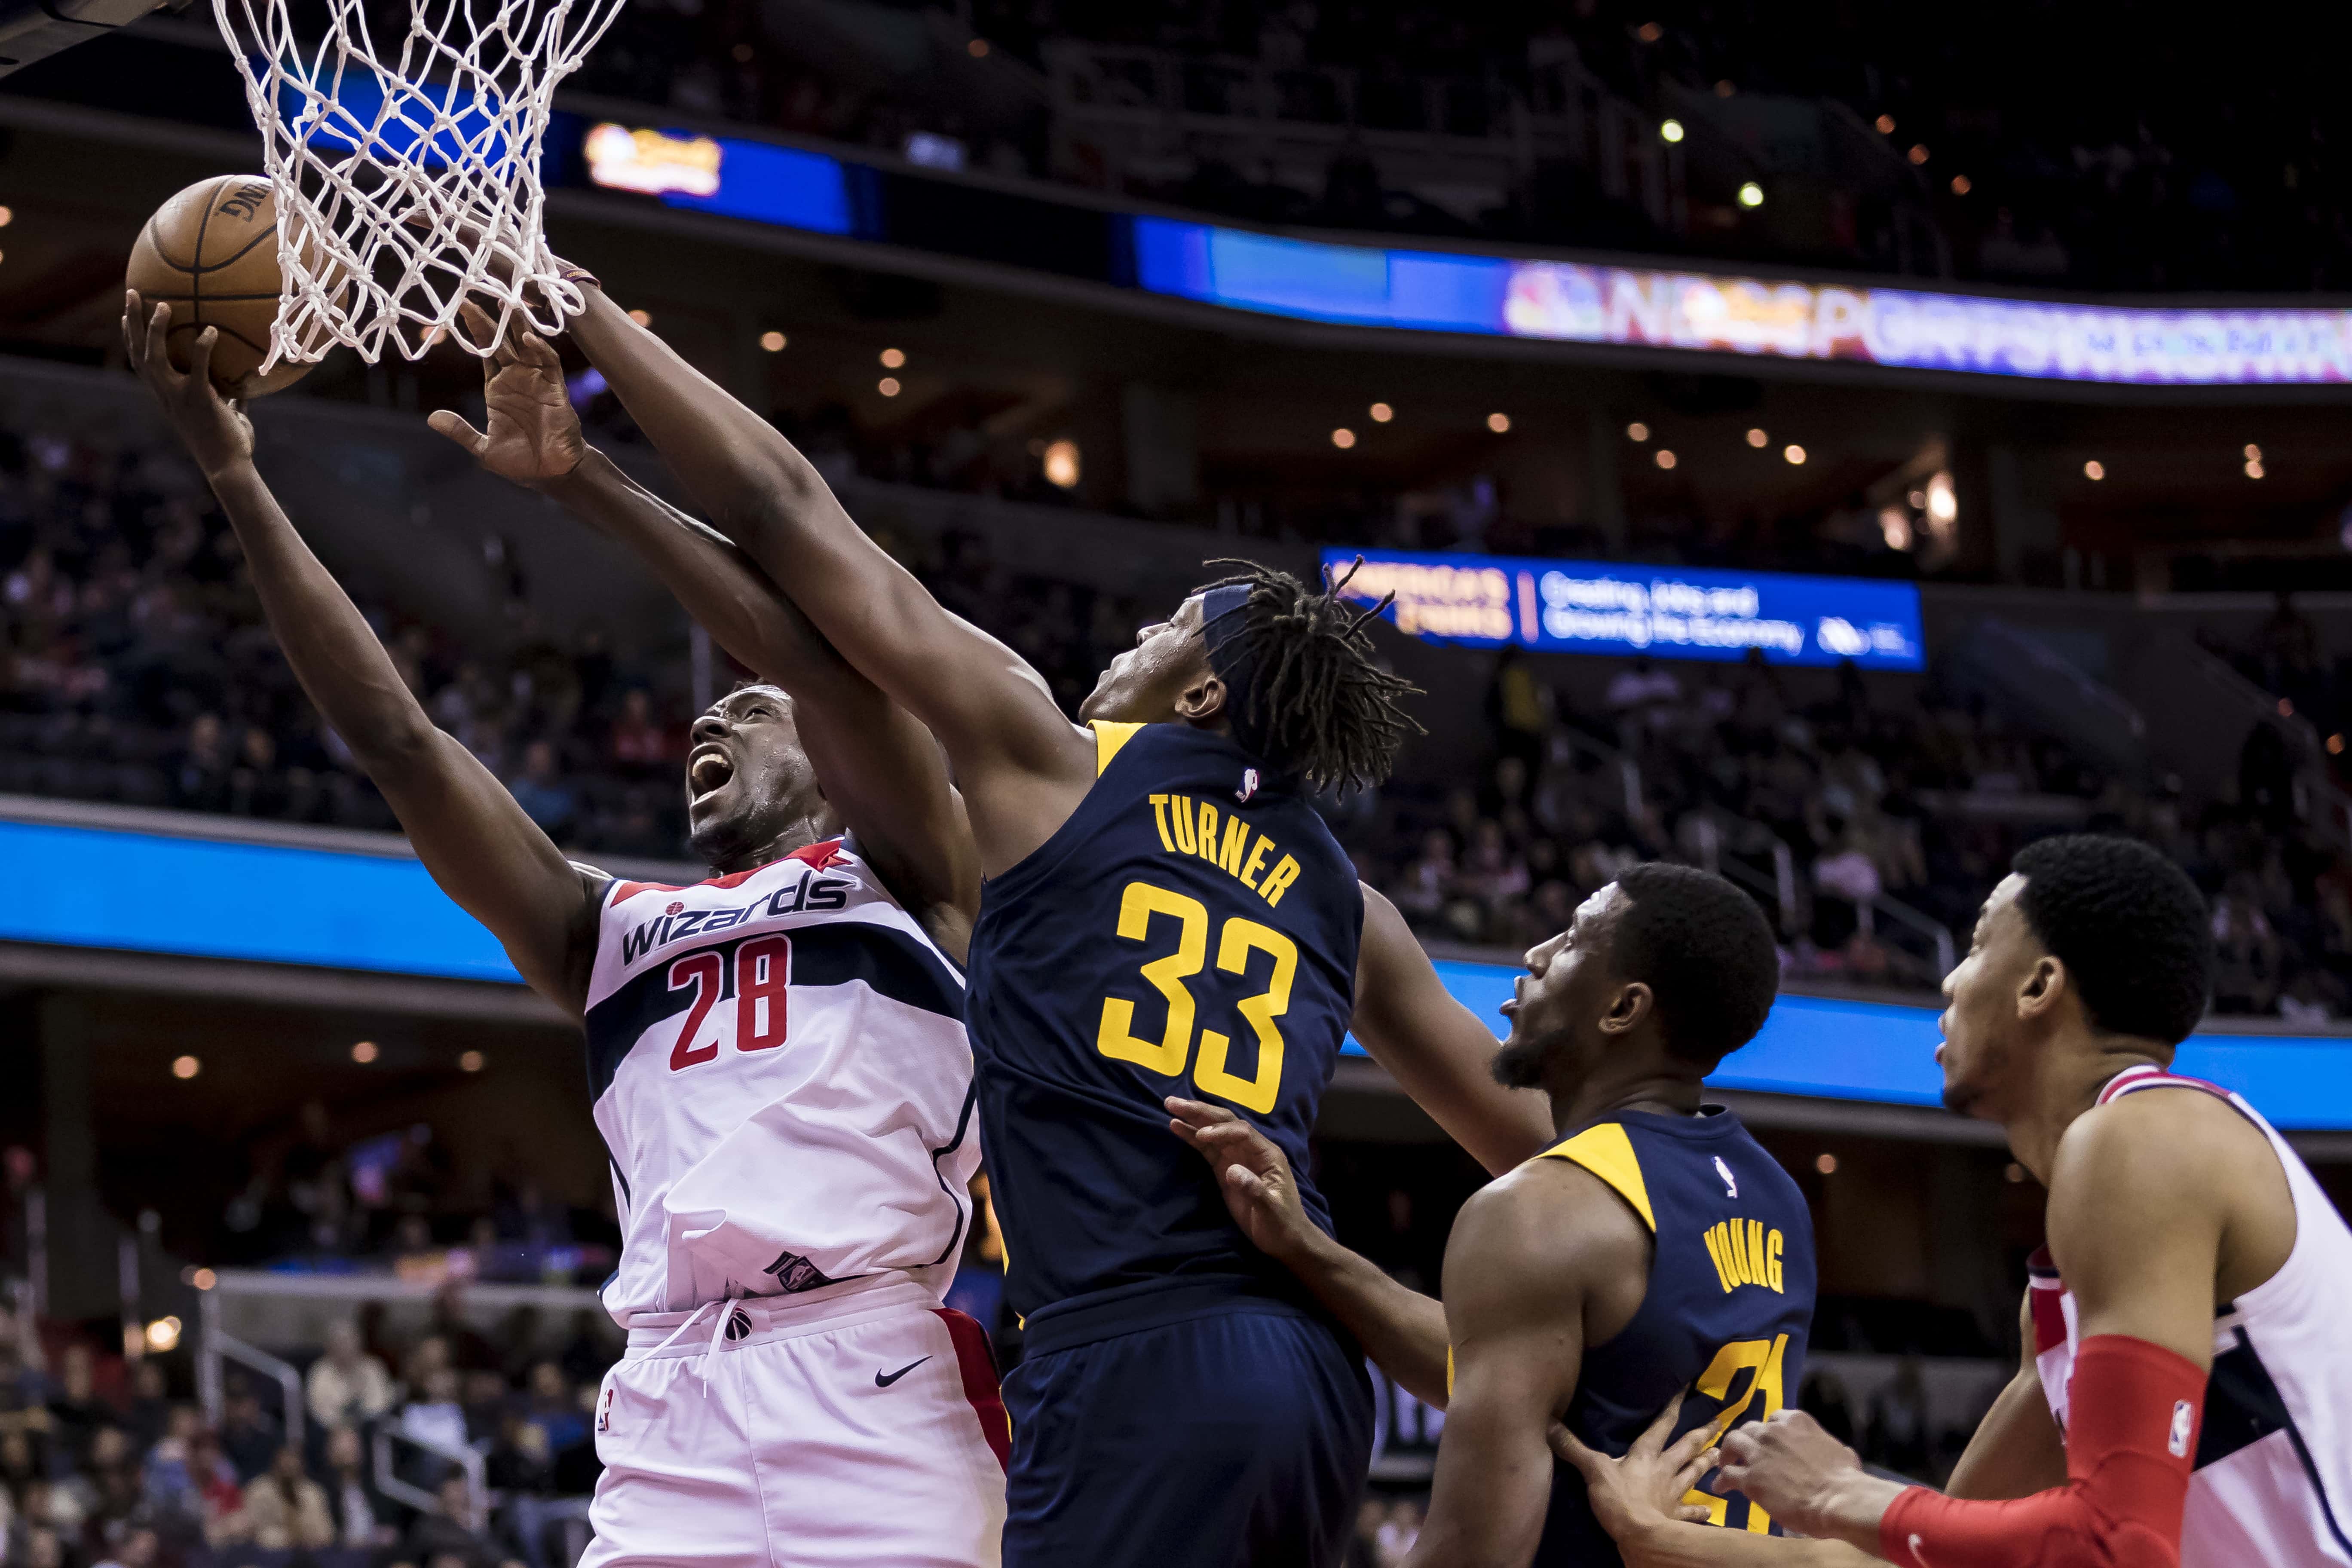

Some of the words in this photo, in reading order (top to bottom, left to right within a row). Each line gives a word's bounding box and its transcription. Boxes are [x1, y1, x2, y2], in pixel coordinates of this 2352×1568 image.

[1149, 794, 1301, 908] TURNER
[668, 934, 791, 1074] 28
[1097, 882, 1298, 1115] 33
[1703, 1218, 1784, 1294] YOUNG
